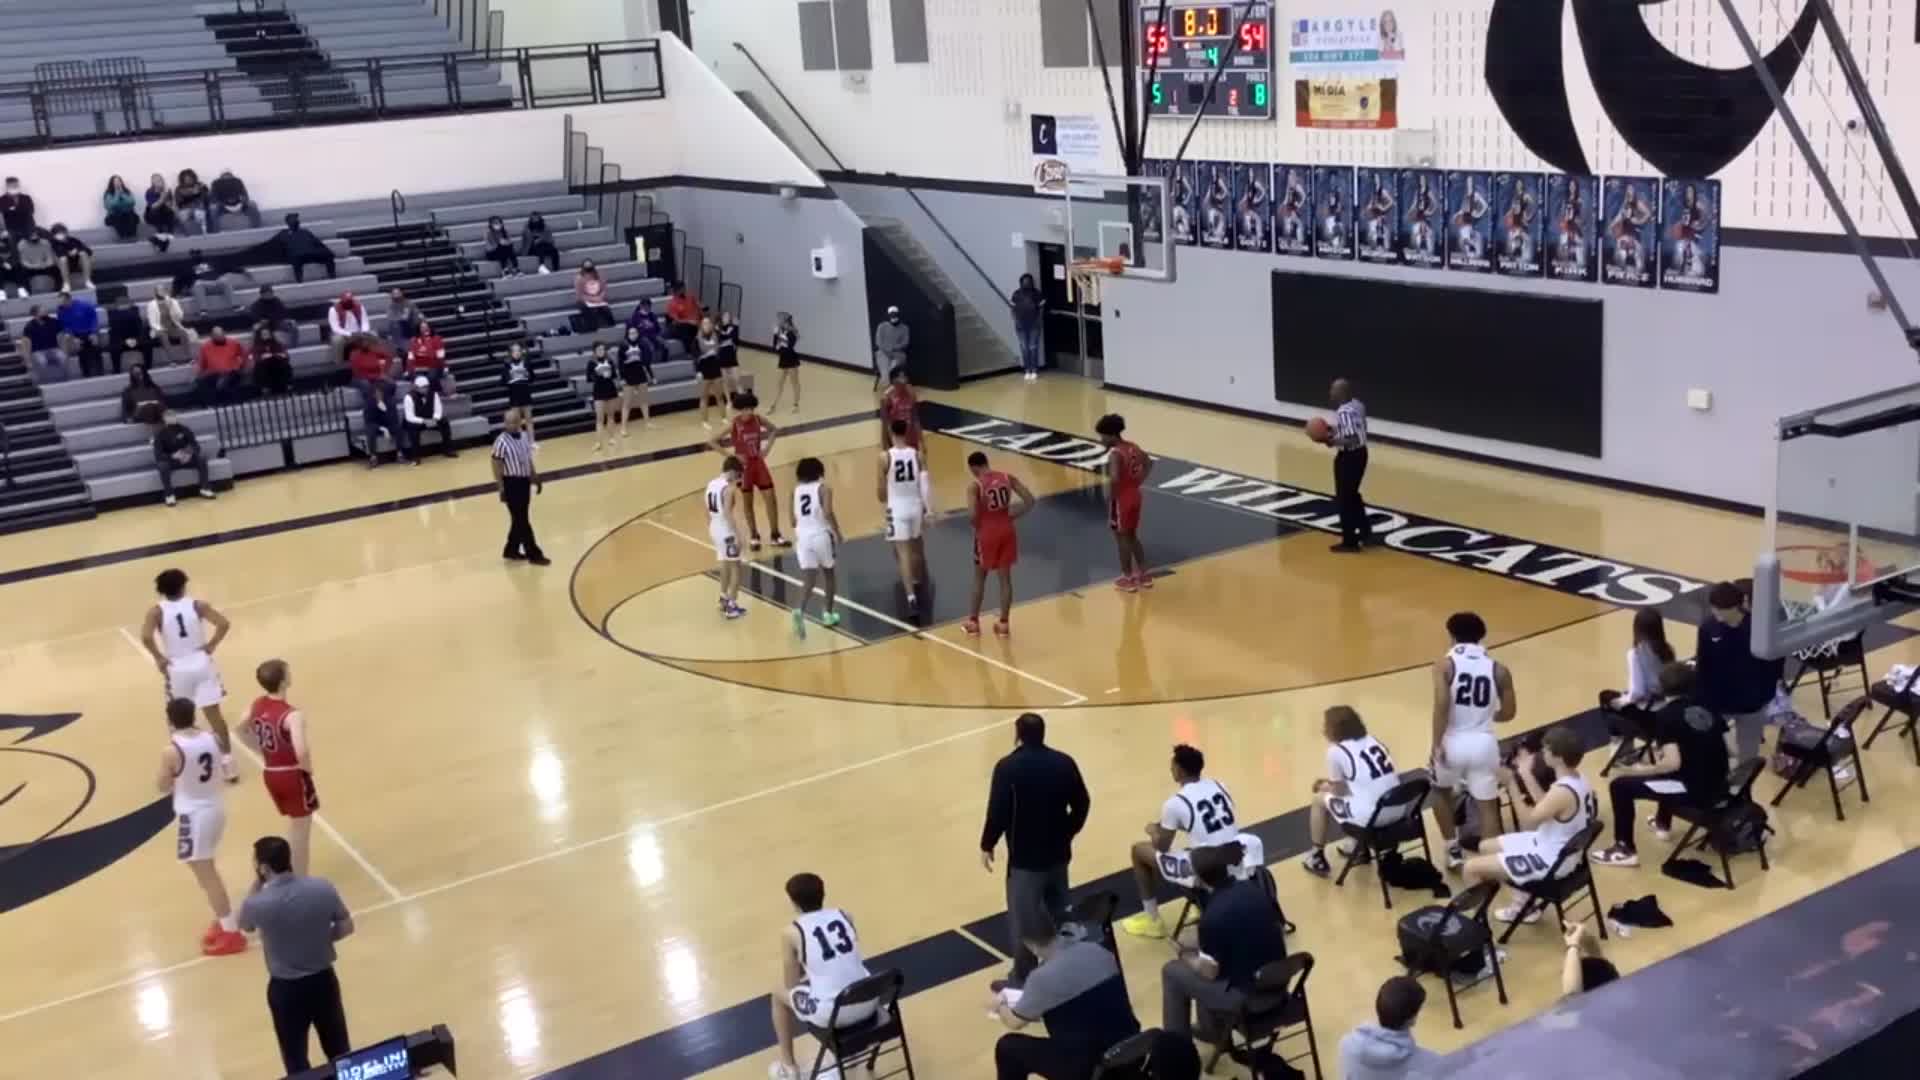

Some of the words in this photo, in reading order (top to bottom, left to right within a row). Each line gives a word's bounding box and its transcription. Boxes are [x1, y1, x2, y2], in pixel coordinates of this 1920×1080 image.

[1146, 25, 1168, 52] 56
[1241, 23, 1264, 51] 54
[1312, 19, 1377, 33] ARGYLE
[1208, 47, 1218, 66] 4
[1152, 83, 1161, 104] 5
[1229, 89, 1238, 105] 2
[1254, 83, 1265, 106] 8
[895, 459, 915, 483] 21
[801, 496, 812, 517] 2
[989, 488, 1010, 510] 30
[1159, 466, 1704, 606] WILDCATS
[176, 613, 188, 638] 1
[1455, 673, 1491, 708] 20
[198, 752, 212, 782] 3
[1361, 742, 1394, 780] 12
[1197, 795, 1236, 834] 23
[813, 919, 855, 961] 13
